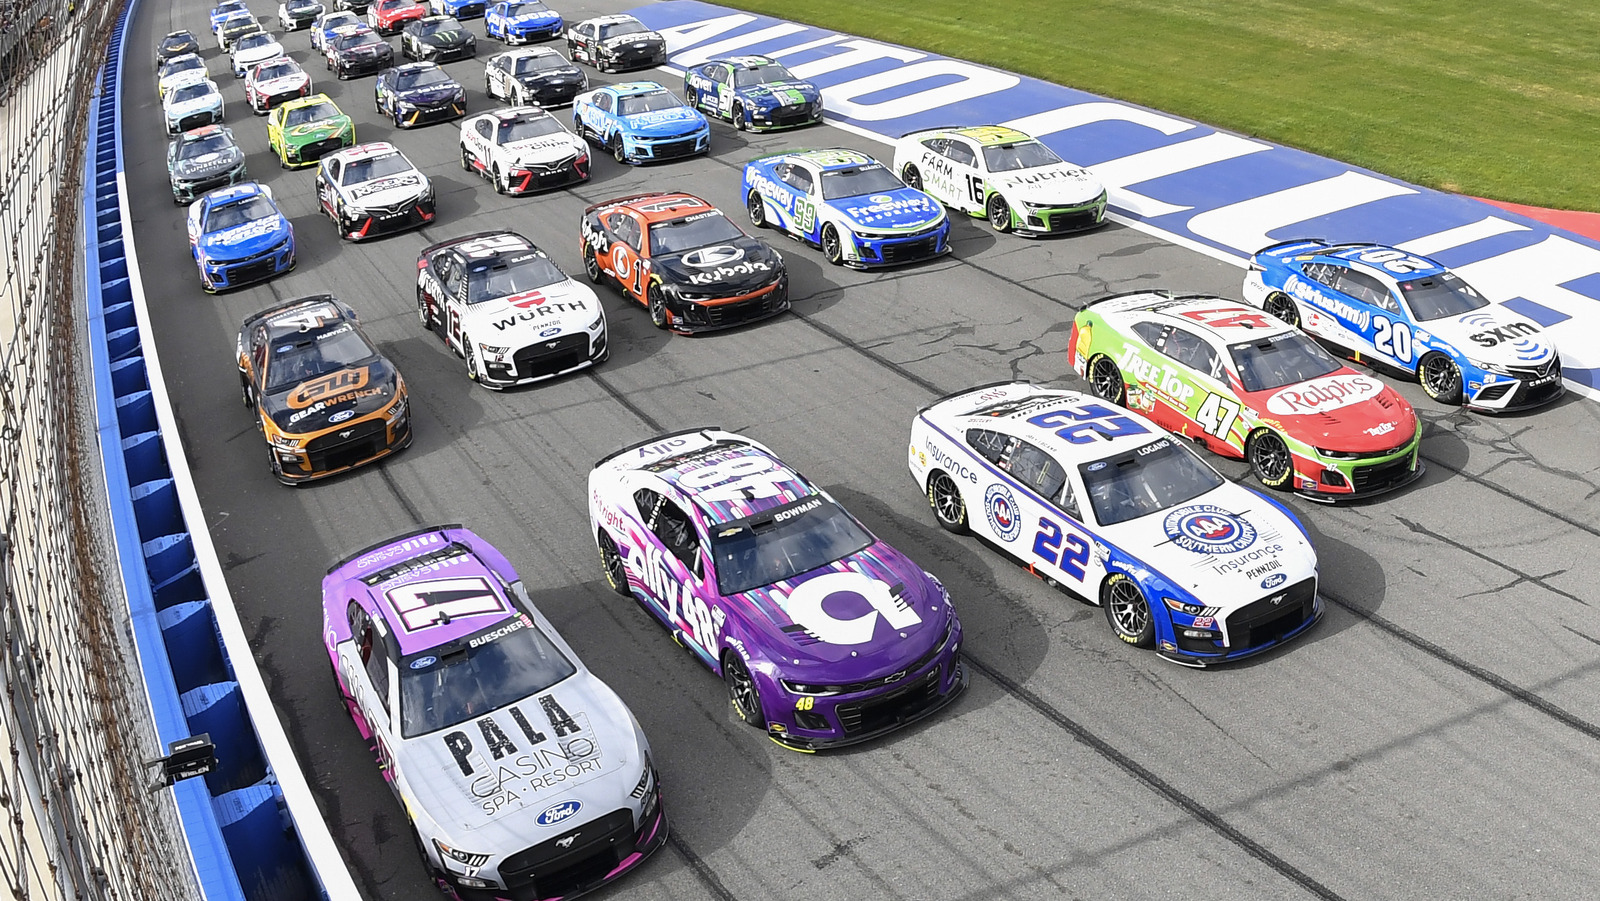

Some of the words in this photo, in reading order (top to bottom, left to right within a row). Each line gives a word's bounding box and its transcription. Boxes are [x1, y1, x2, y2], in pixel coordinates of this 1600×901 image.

[655, 14, 1021, 122] AUTO
[921, 152, 953, 180] FARM
[1003, 168, 1093, 188] Nutrien
[924, 170, 963, 201] SMART
[965, 174, 984, 205] 16
[793, 196, 816, 234] 99
[847, 196, 929, 218] Freeway
[633, 258, 642, 295] 1
[689, 262, 771, 285] Kubota
[492, 300, 588, 331] WÜRTH
[316, 327, 349, 341] HARVICK
[1373, 315, 1413, 364] 20
[1118, 342, 1161, 386] TREE
[1160, 364, 1195, 402] TOP
[1483, 374, 1496, 383] 20
[1529, 375, 1557, 387] CAMRY
[289, 387, 382, 423] GEARWRENCH
[1277, 377, 1373, 412] Ralphs
[1026, 404, 1153, 445] 22
[1196, 392, 1241, 441] 47
[638, 438, 687, 459] ally
[925, 436, 978, 484] Insurance
[1137, 439, 1170, 456] LOGANO
[602, 505, 626, 531] right.
[774, 499, 822, 523] BOWMAN
[994, 501, 1012, 521] AAA
[1190, 517, 1229, 537] AAA
[402, 534, 438, 552] PALA
[1032, 517, 1090, 583] 22
[1175, 535, 1237, 553] SOUTHERN
[1212, 543, 1284, 576] Insurance
[1245, 559, 1283, 580] PENNZOIL
[388, 578, 502, 630] 17
[682, 578, 719, 661] 48
[1192, 616, 1214, 627] 22
[469, 620, 525, 649] BUESCHER
[795, 696, 814, 711] 48
[443, 693, 582, 777] PALA
[470, 737, 595, 798] CASINO
[482, 790, 521, 817] SPA
[532, 758, 603, 793] RESORT
[541, 801, 577, 825] Ford
[464, 865, 481, 878] 17
